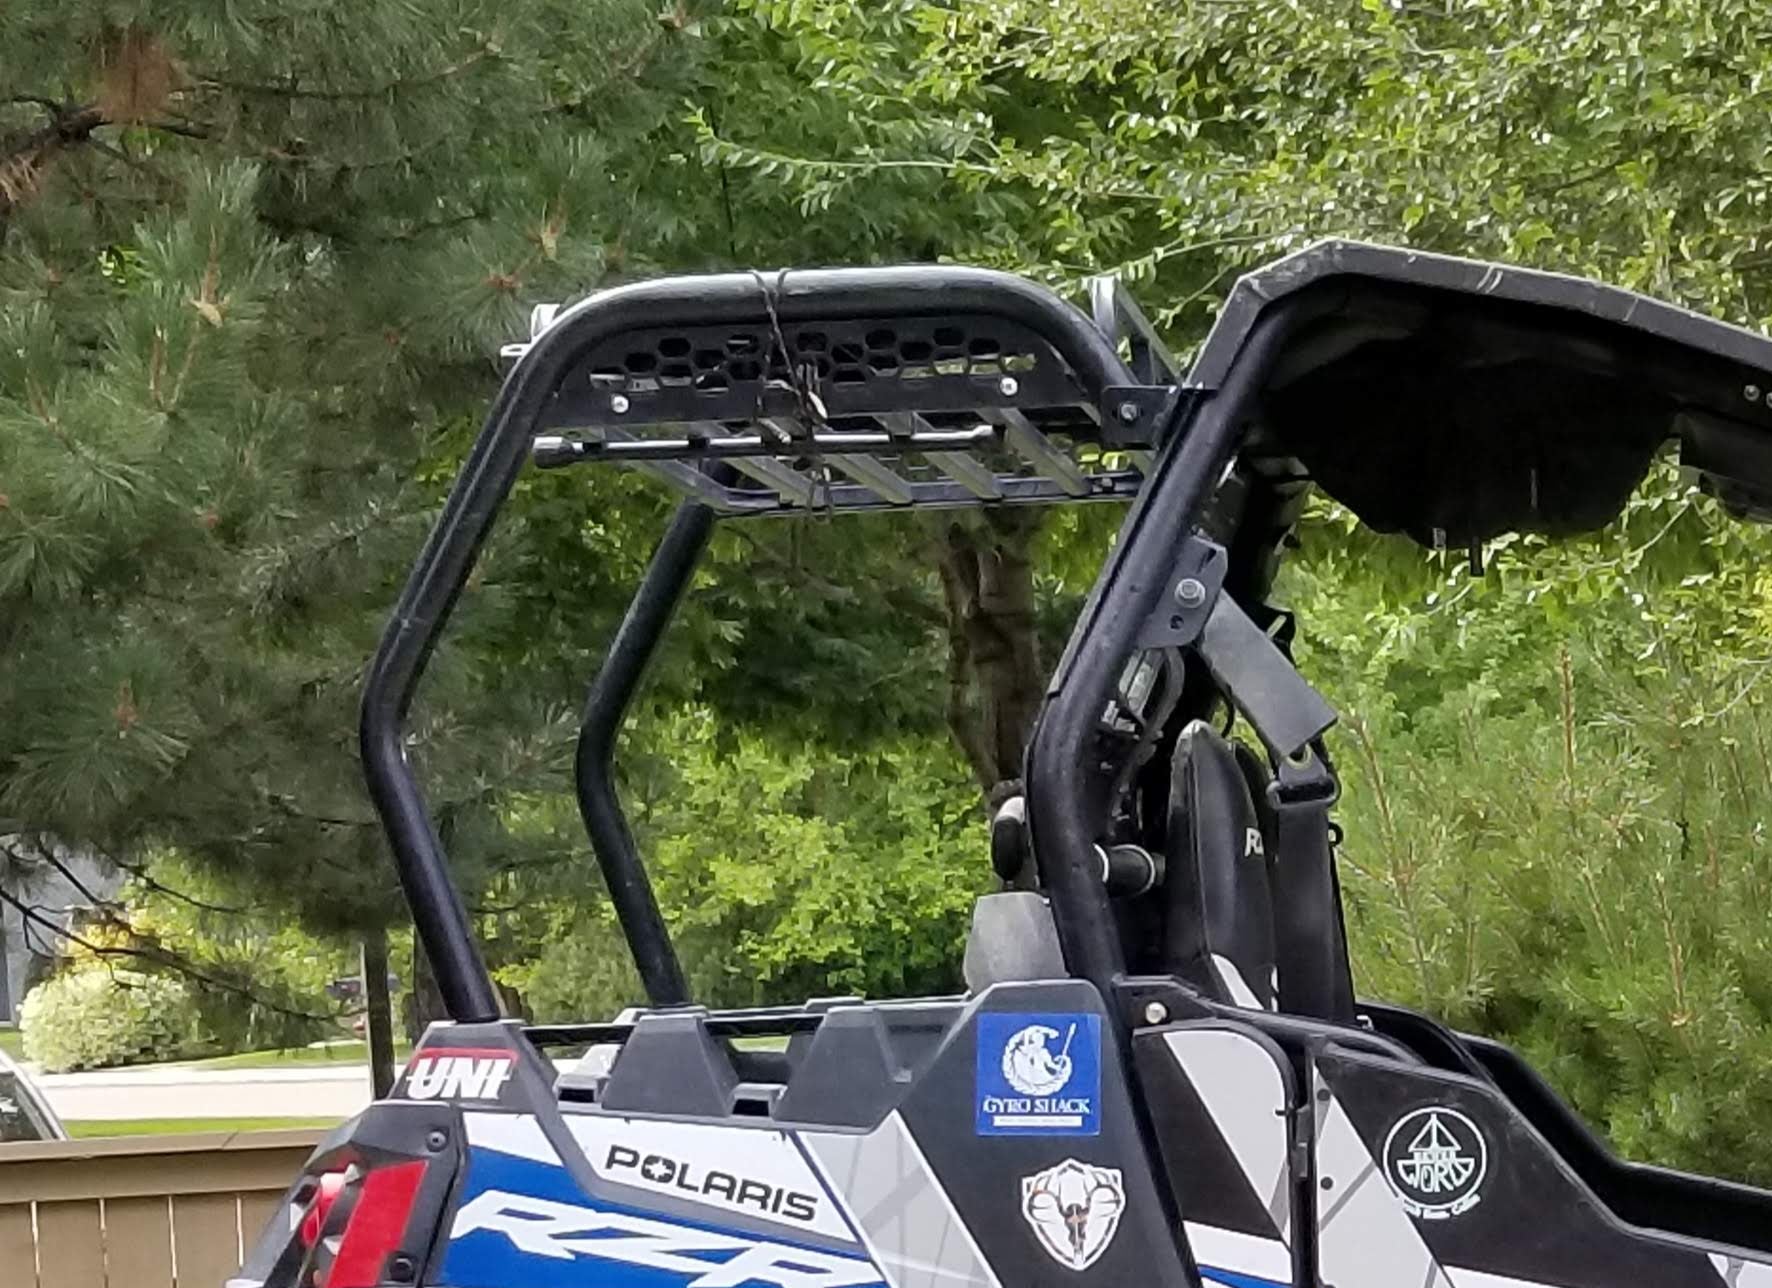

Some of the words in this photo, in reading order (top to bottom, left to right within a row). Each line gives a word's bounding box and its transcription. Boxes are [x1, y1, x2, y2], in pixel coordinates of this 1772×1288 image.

[406, 1057, 512, 1100] UNI
[983, 1097, 1031, 1114] GYRO
[1034, 1097, 1091, 1114] SHACK
[604, 1144, 818, 1222] POLARIS
